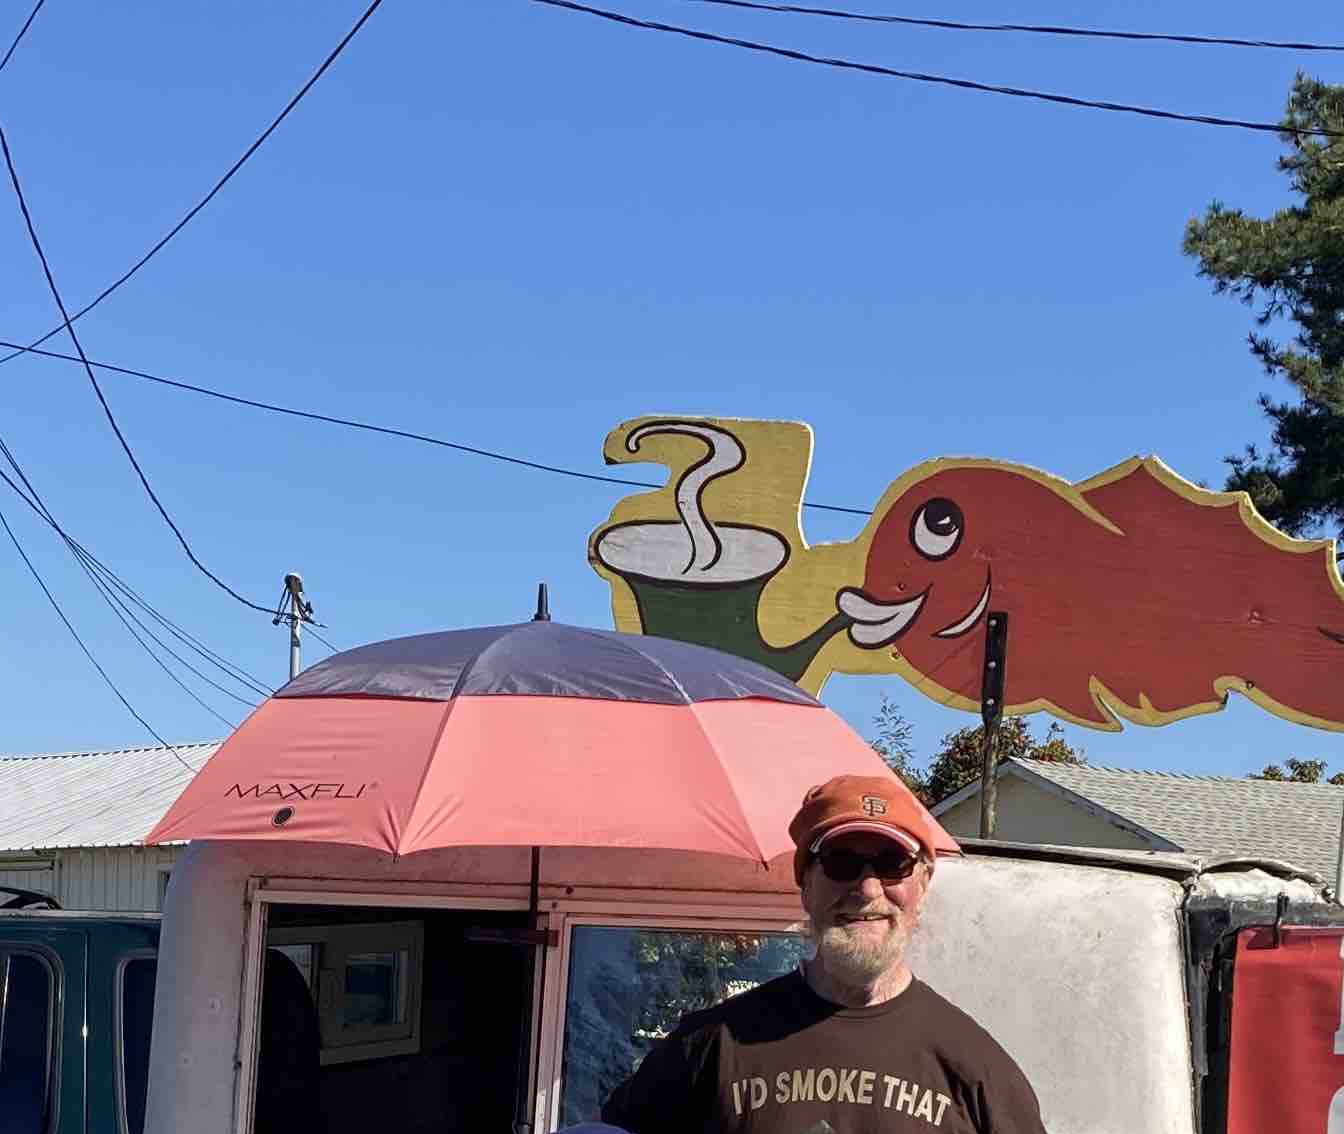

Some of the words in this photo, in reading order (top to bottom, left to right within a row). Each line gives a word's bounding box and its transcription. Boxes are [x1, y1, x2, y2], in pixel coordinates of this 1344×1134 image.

[224, 783, 367, 800] MAXFLI
[731, 1077, 769, 1116] I'D
[775, 1067, 877, 1105] SMOKE
[883, 1074, 953, 1127] THAT
